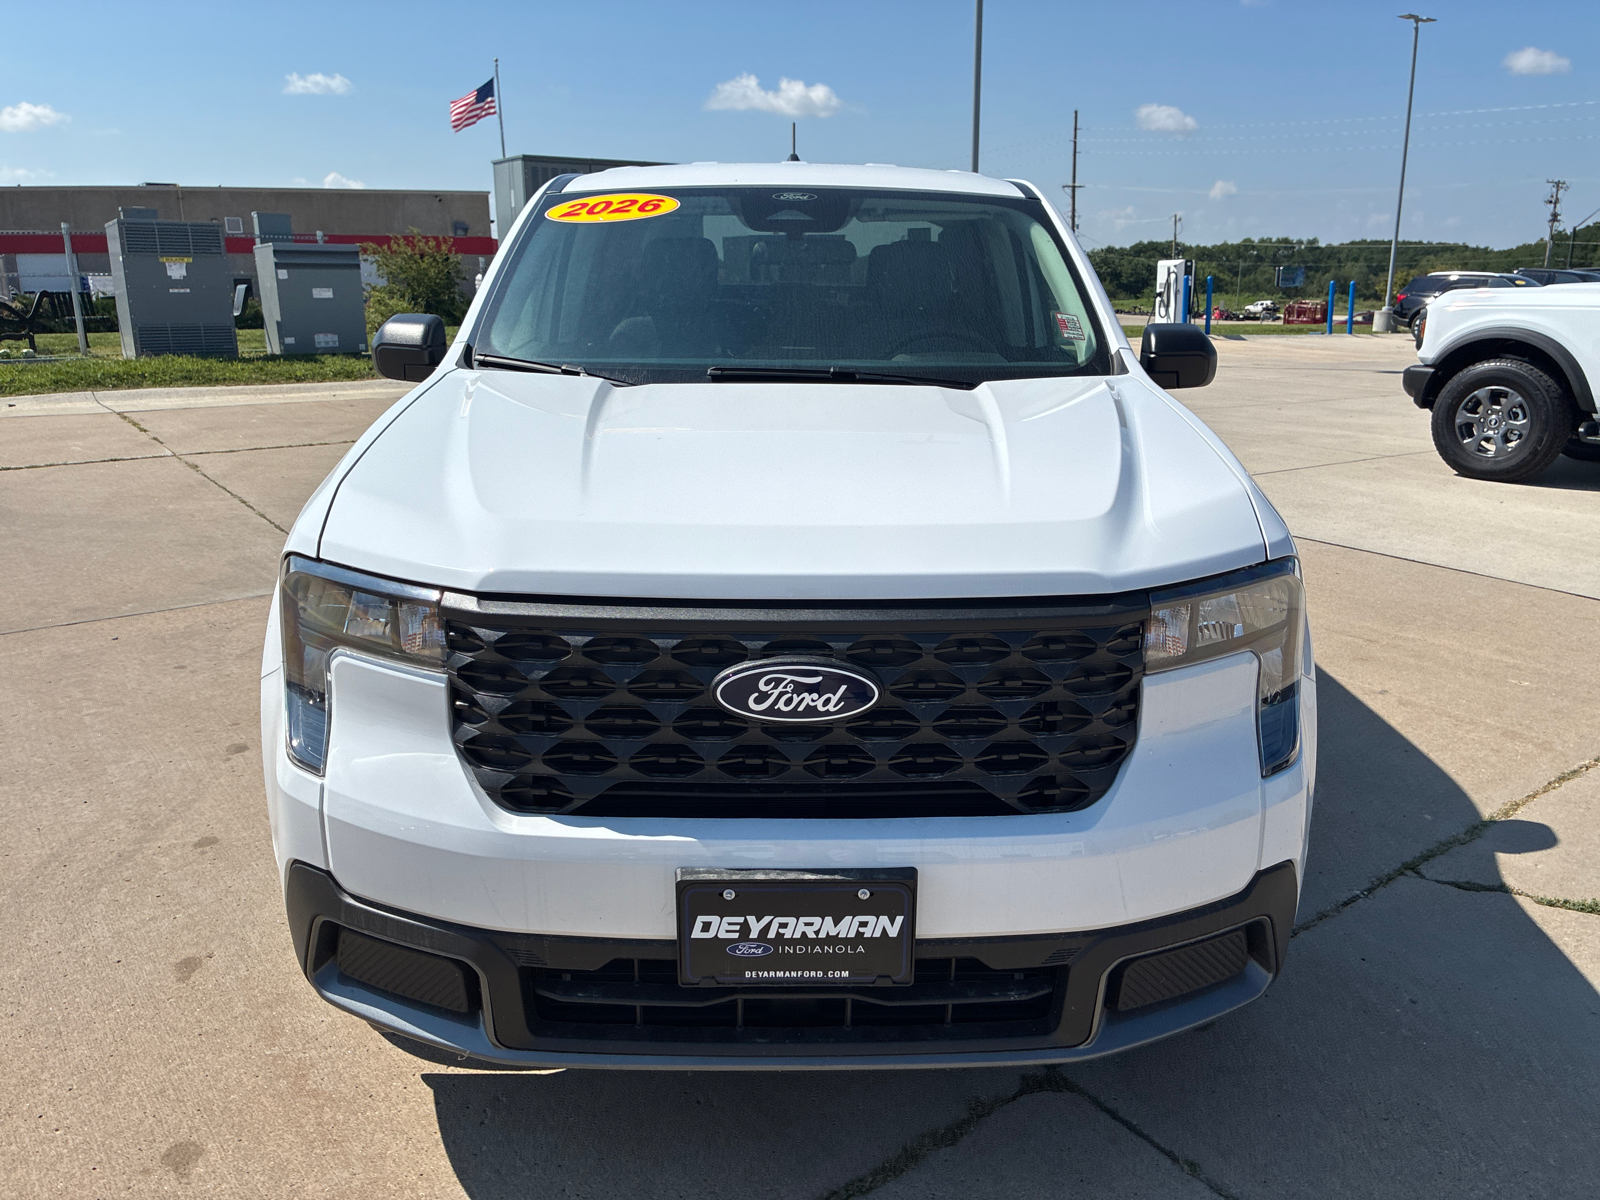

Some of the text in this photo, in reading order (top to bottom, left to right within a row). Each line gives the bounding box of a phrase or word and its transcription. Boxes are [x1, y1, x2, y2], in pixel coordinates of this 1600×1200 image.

[557, 198, 667, 218] 2026
[748, 673, 848, 712] Ford
[690, 915, 905, 939] DEYARMAN
[735, 944, 866, 954] Ford INDIANOLA
[745, 970, 849, 978] DEYARMANFORD.COM
